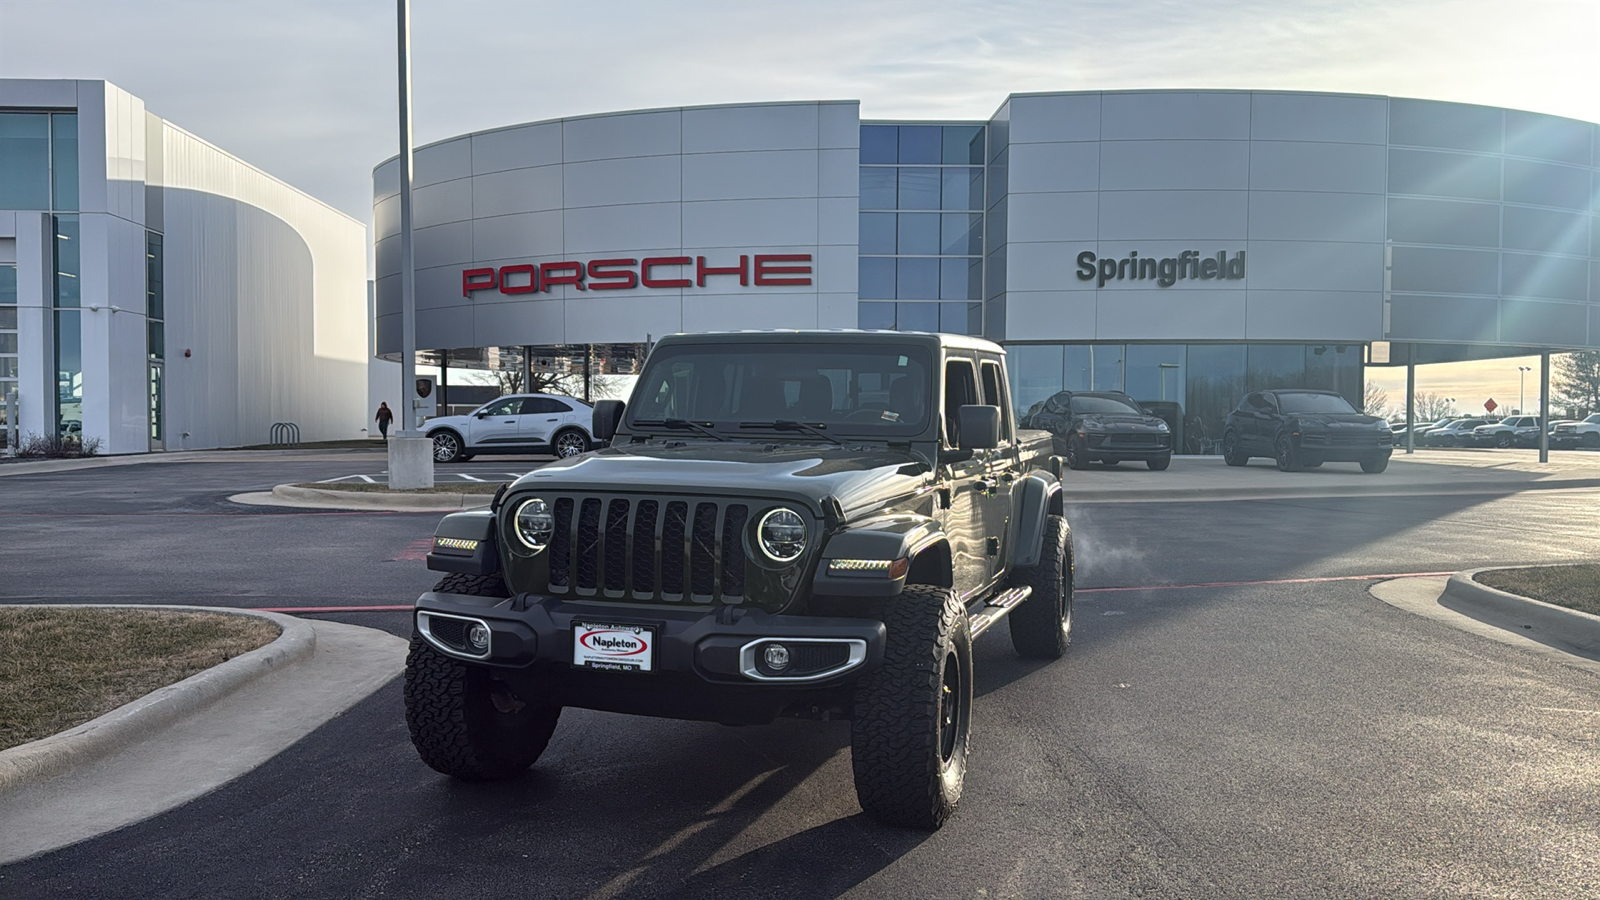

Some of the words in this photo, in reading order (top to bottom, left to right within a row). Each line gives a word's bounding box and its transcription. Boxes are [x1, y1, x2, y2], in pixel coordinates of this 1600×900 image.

[462, 253, 813, 298] PORSCHE
[1076, 250, 1246, 288] Springfield
[581, 622, 609, 630] Napleton
[593, 636, 637, 648] Napleton
